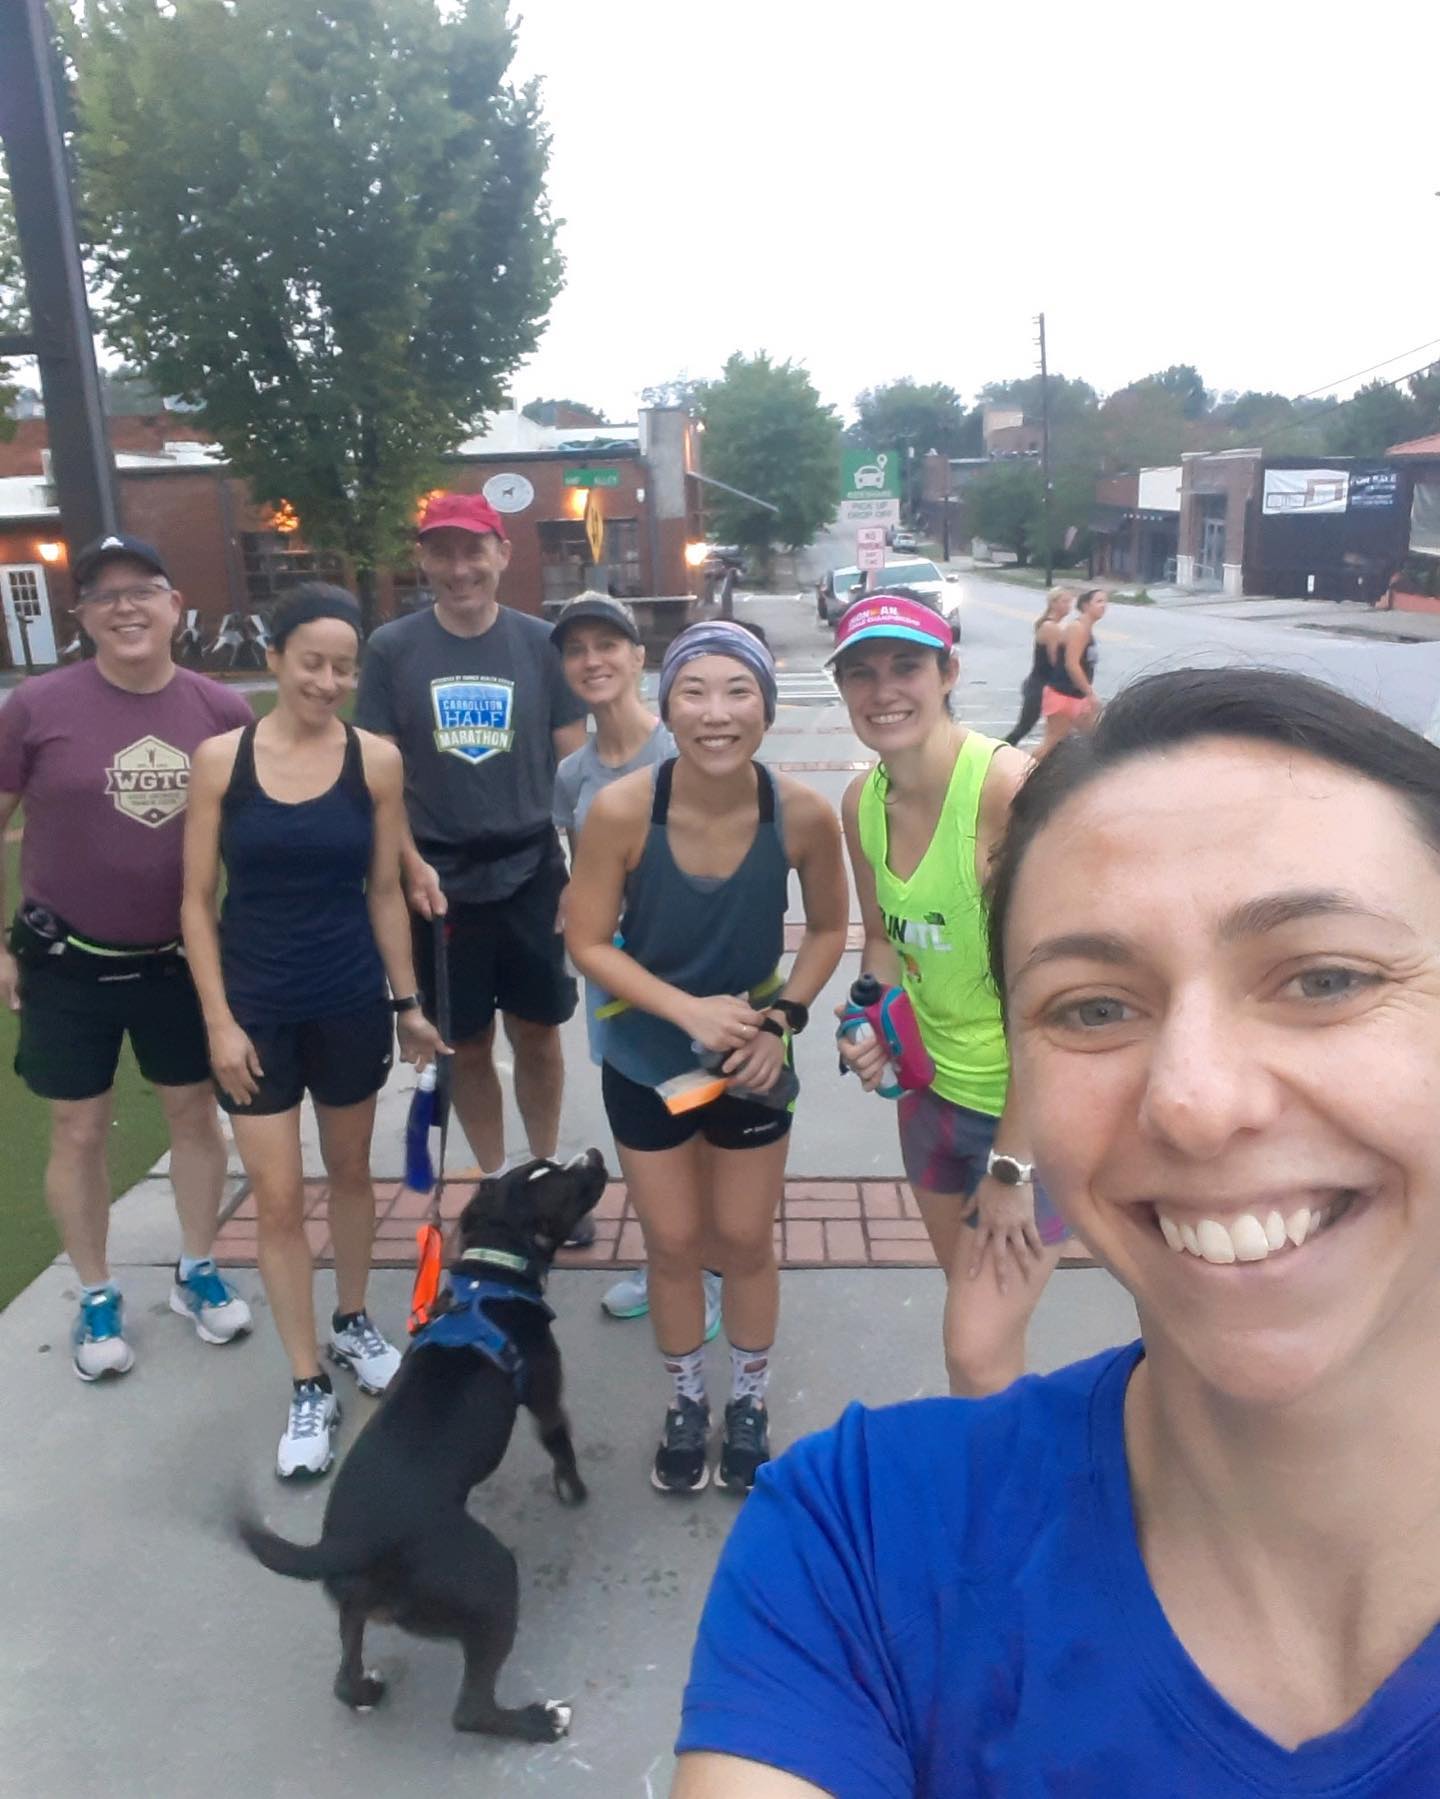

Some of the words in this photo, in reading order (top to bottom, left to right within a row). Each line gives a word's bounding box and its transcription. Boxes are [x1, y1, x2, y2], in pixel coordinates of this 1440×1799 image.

[442, 699, 503, 711] CARROLLTON
[444, 710, 504, 729] HALF
[439, 729, 509, 749] MARATHON
[113, 770, 190, 790] WGTC
